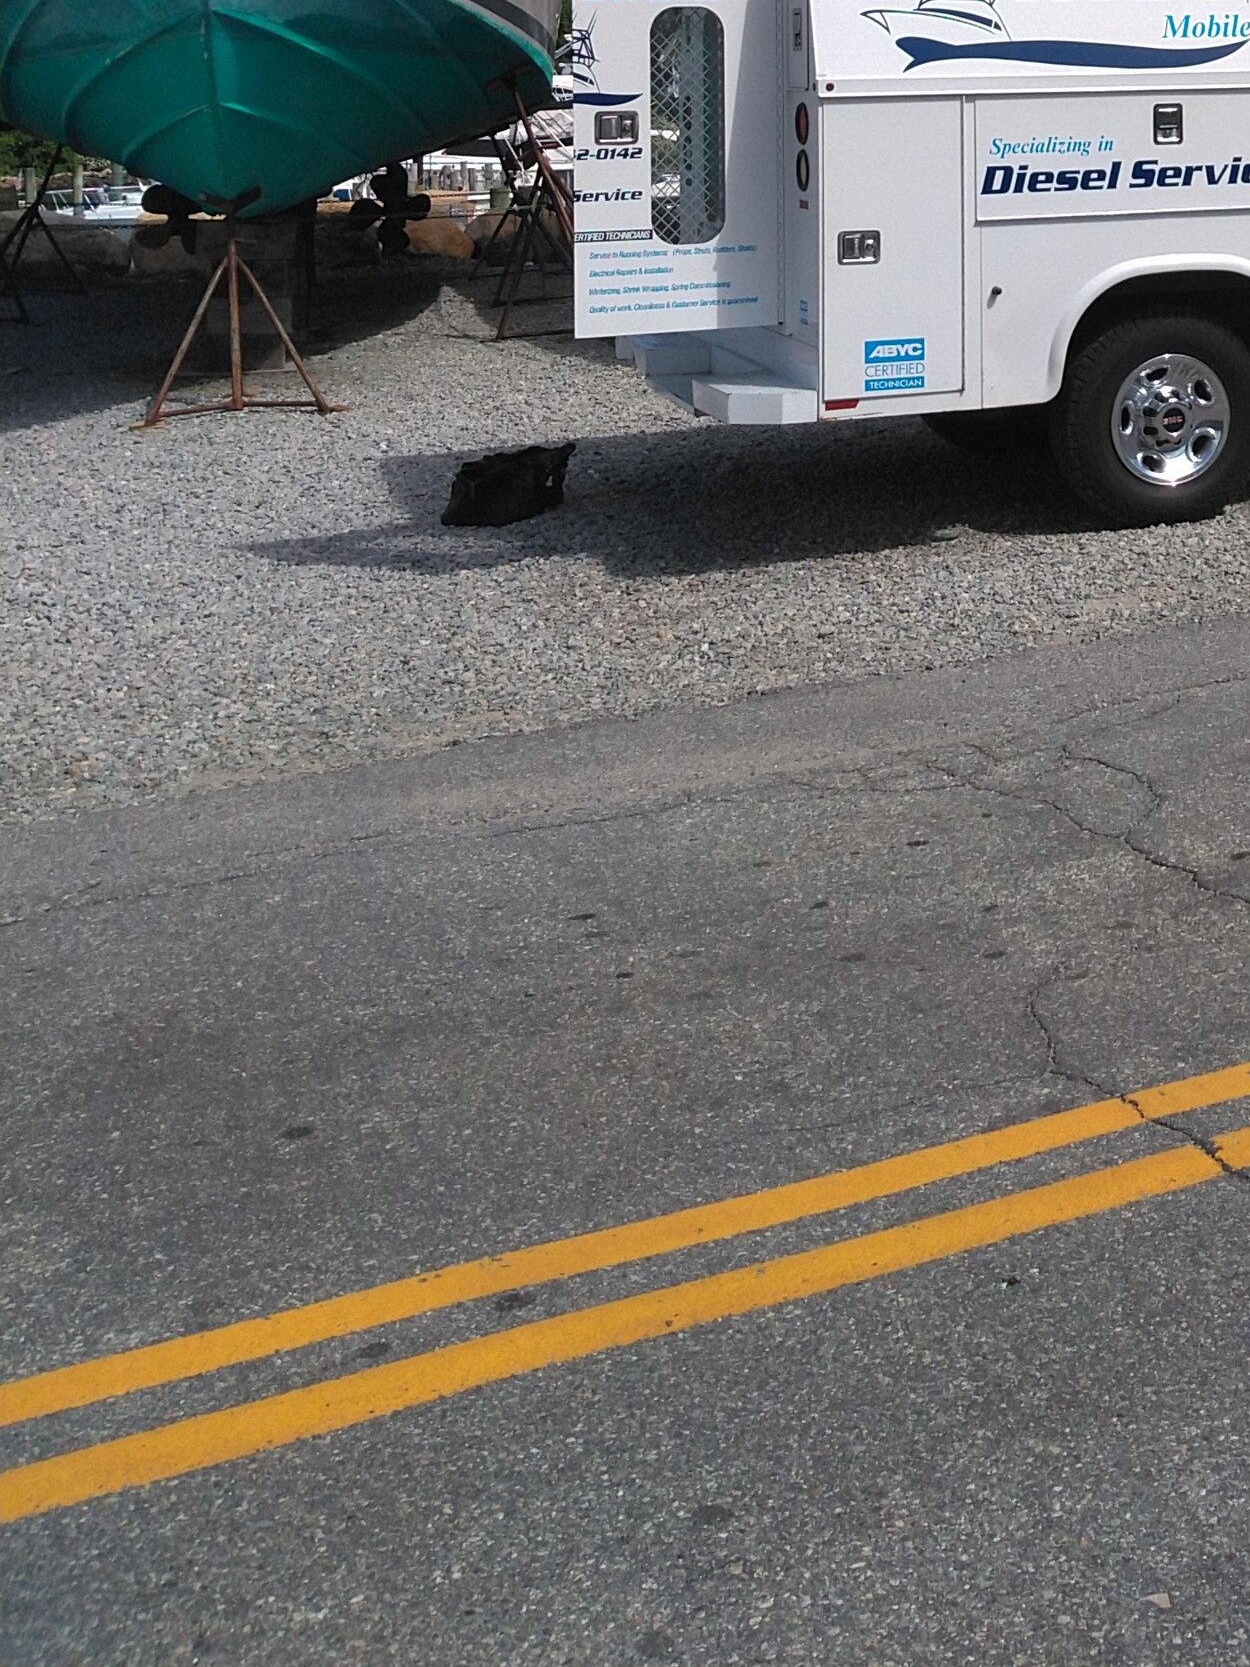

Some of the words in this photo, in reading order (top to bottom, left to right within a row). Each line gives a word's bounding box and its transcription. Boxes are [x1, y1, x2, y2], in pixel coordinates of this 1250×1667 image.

[574, 147, 643, 161] 2-0142
[989, 136, 1092, 159] Specializing
[1097, 135, 1114, 152] in
[980, 160, 1122, 195] Diesel
[605, 230, 651, 241] TECHNICIANS
[868, 342, 923, 359] ABYC
[865, 362, 925, 378] CERTIFIED
[869, 379, 922, 389] TECHNICIAN
